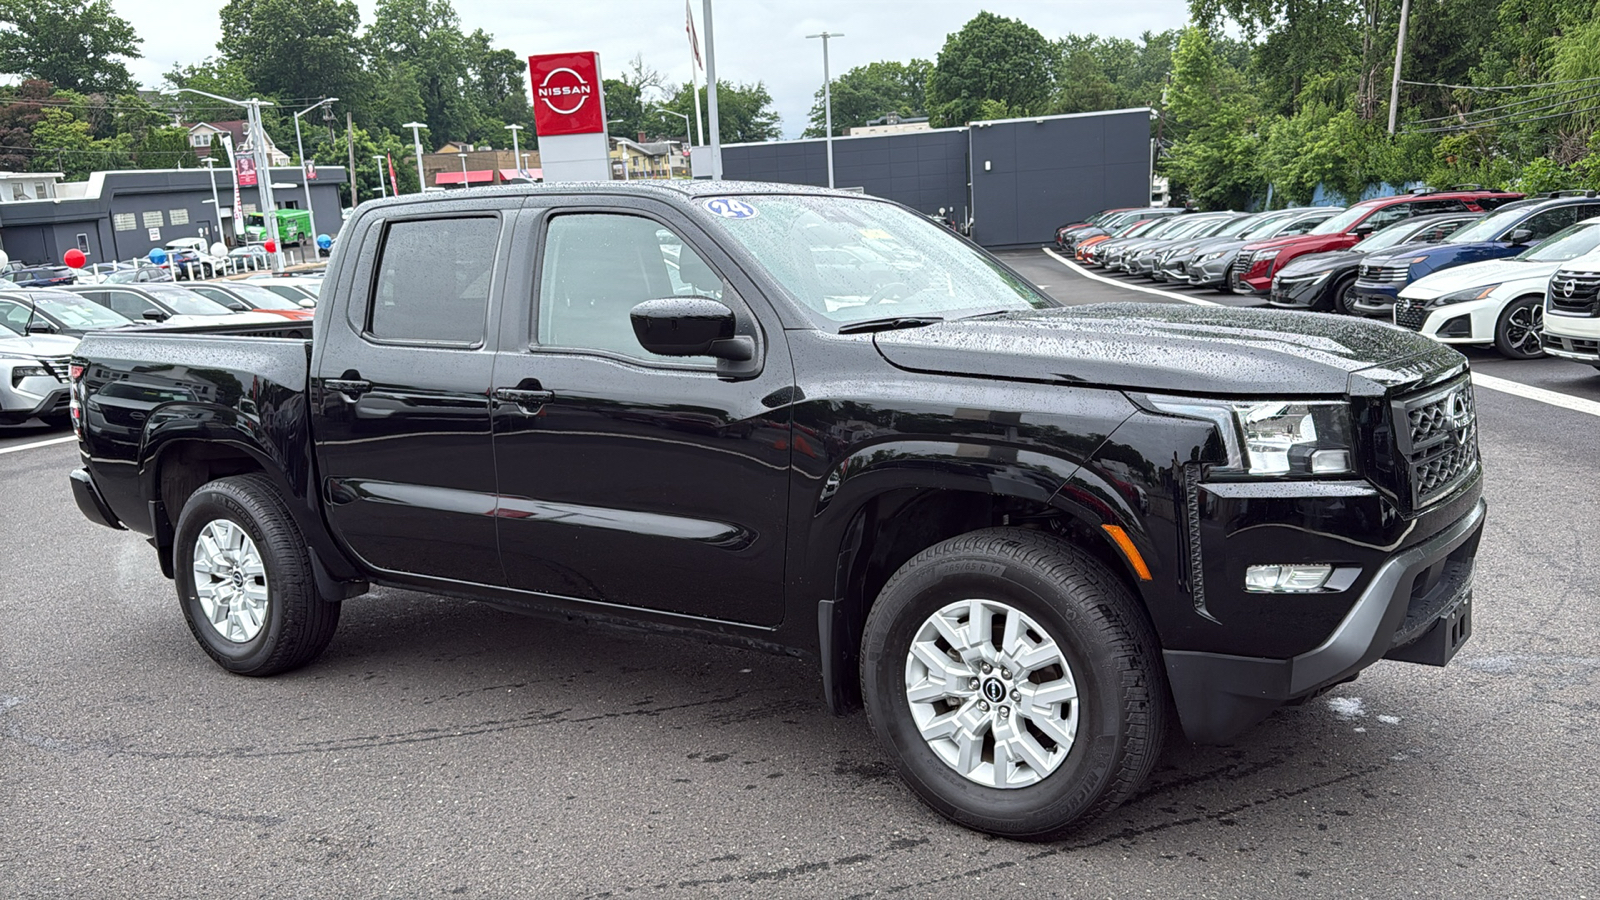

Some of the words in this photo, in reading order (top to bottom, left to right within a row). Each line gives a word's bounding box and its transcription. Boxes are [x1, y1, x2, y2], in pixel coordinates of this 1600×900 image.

[538, 85, 591, 97] NISSAN
[710, 199, 753, 218] 24
[227, 500, 262, 541] MICHELIN
[945, 562, 977, 573] 265/65
[980, 564, 986, 572] R
[990, 565, 1000, 574] 17
